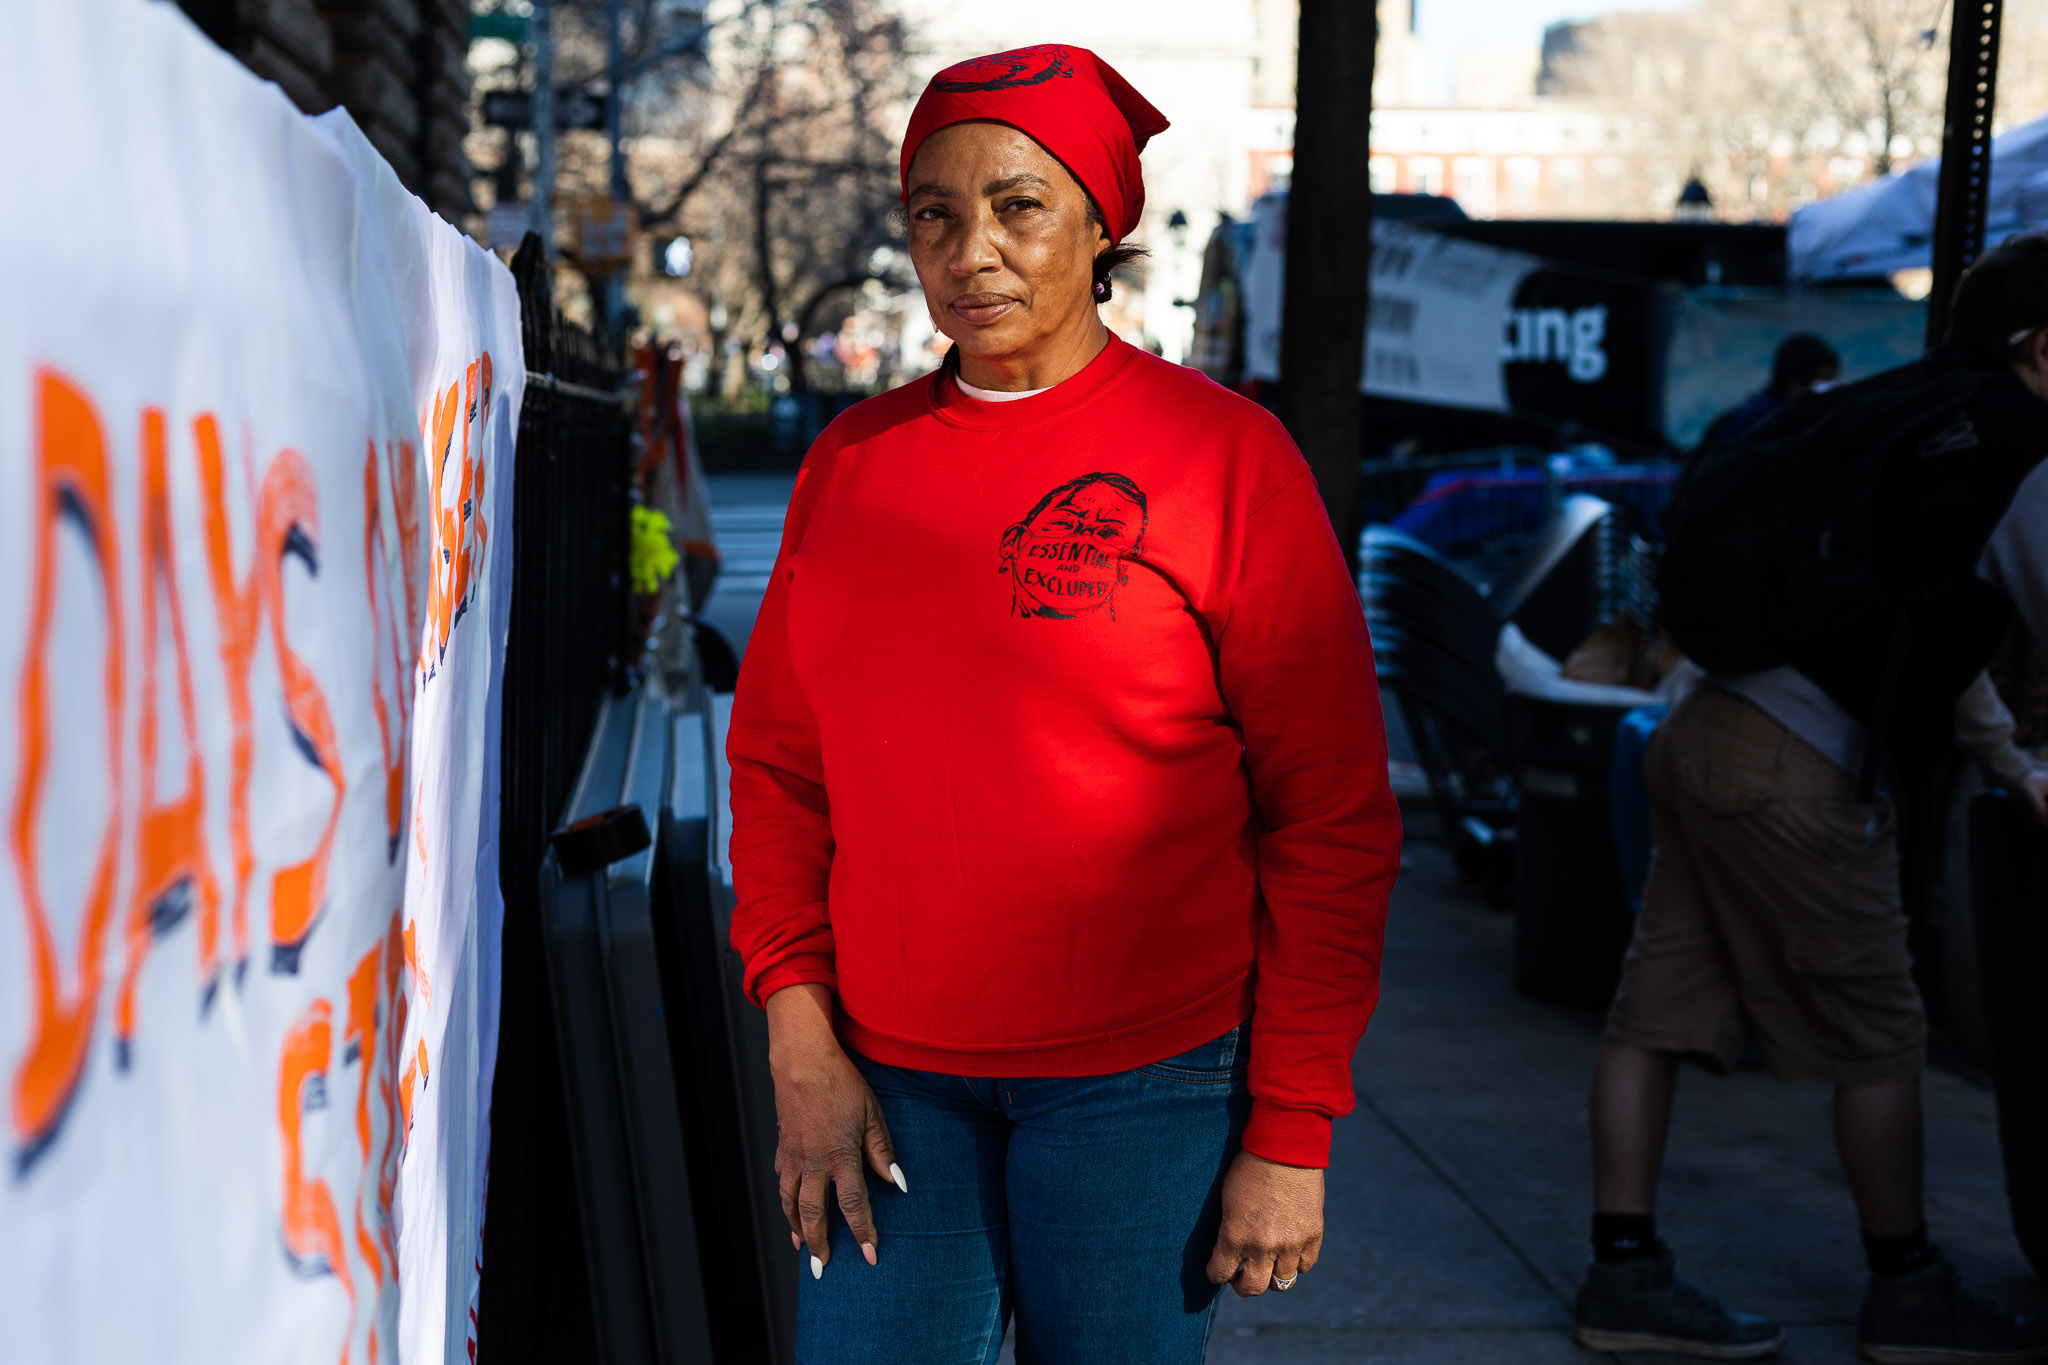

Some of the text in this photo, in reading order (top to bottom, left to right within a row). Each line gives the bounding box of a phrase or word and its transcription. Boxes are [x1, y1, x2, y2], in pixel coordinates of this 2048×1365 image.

[1028, 541, 1113, 568] ESSENTIAL
[1056, 564, 1080, 573] AND
[1024, 568, 1108, 597] EXCLUDED
[9, 363, 347, 1180] DAYS
